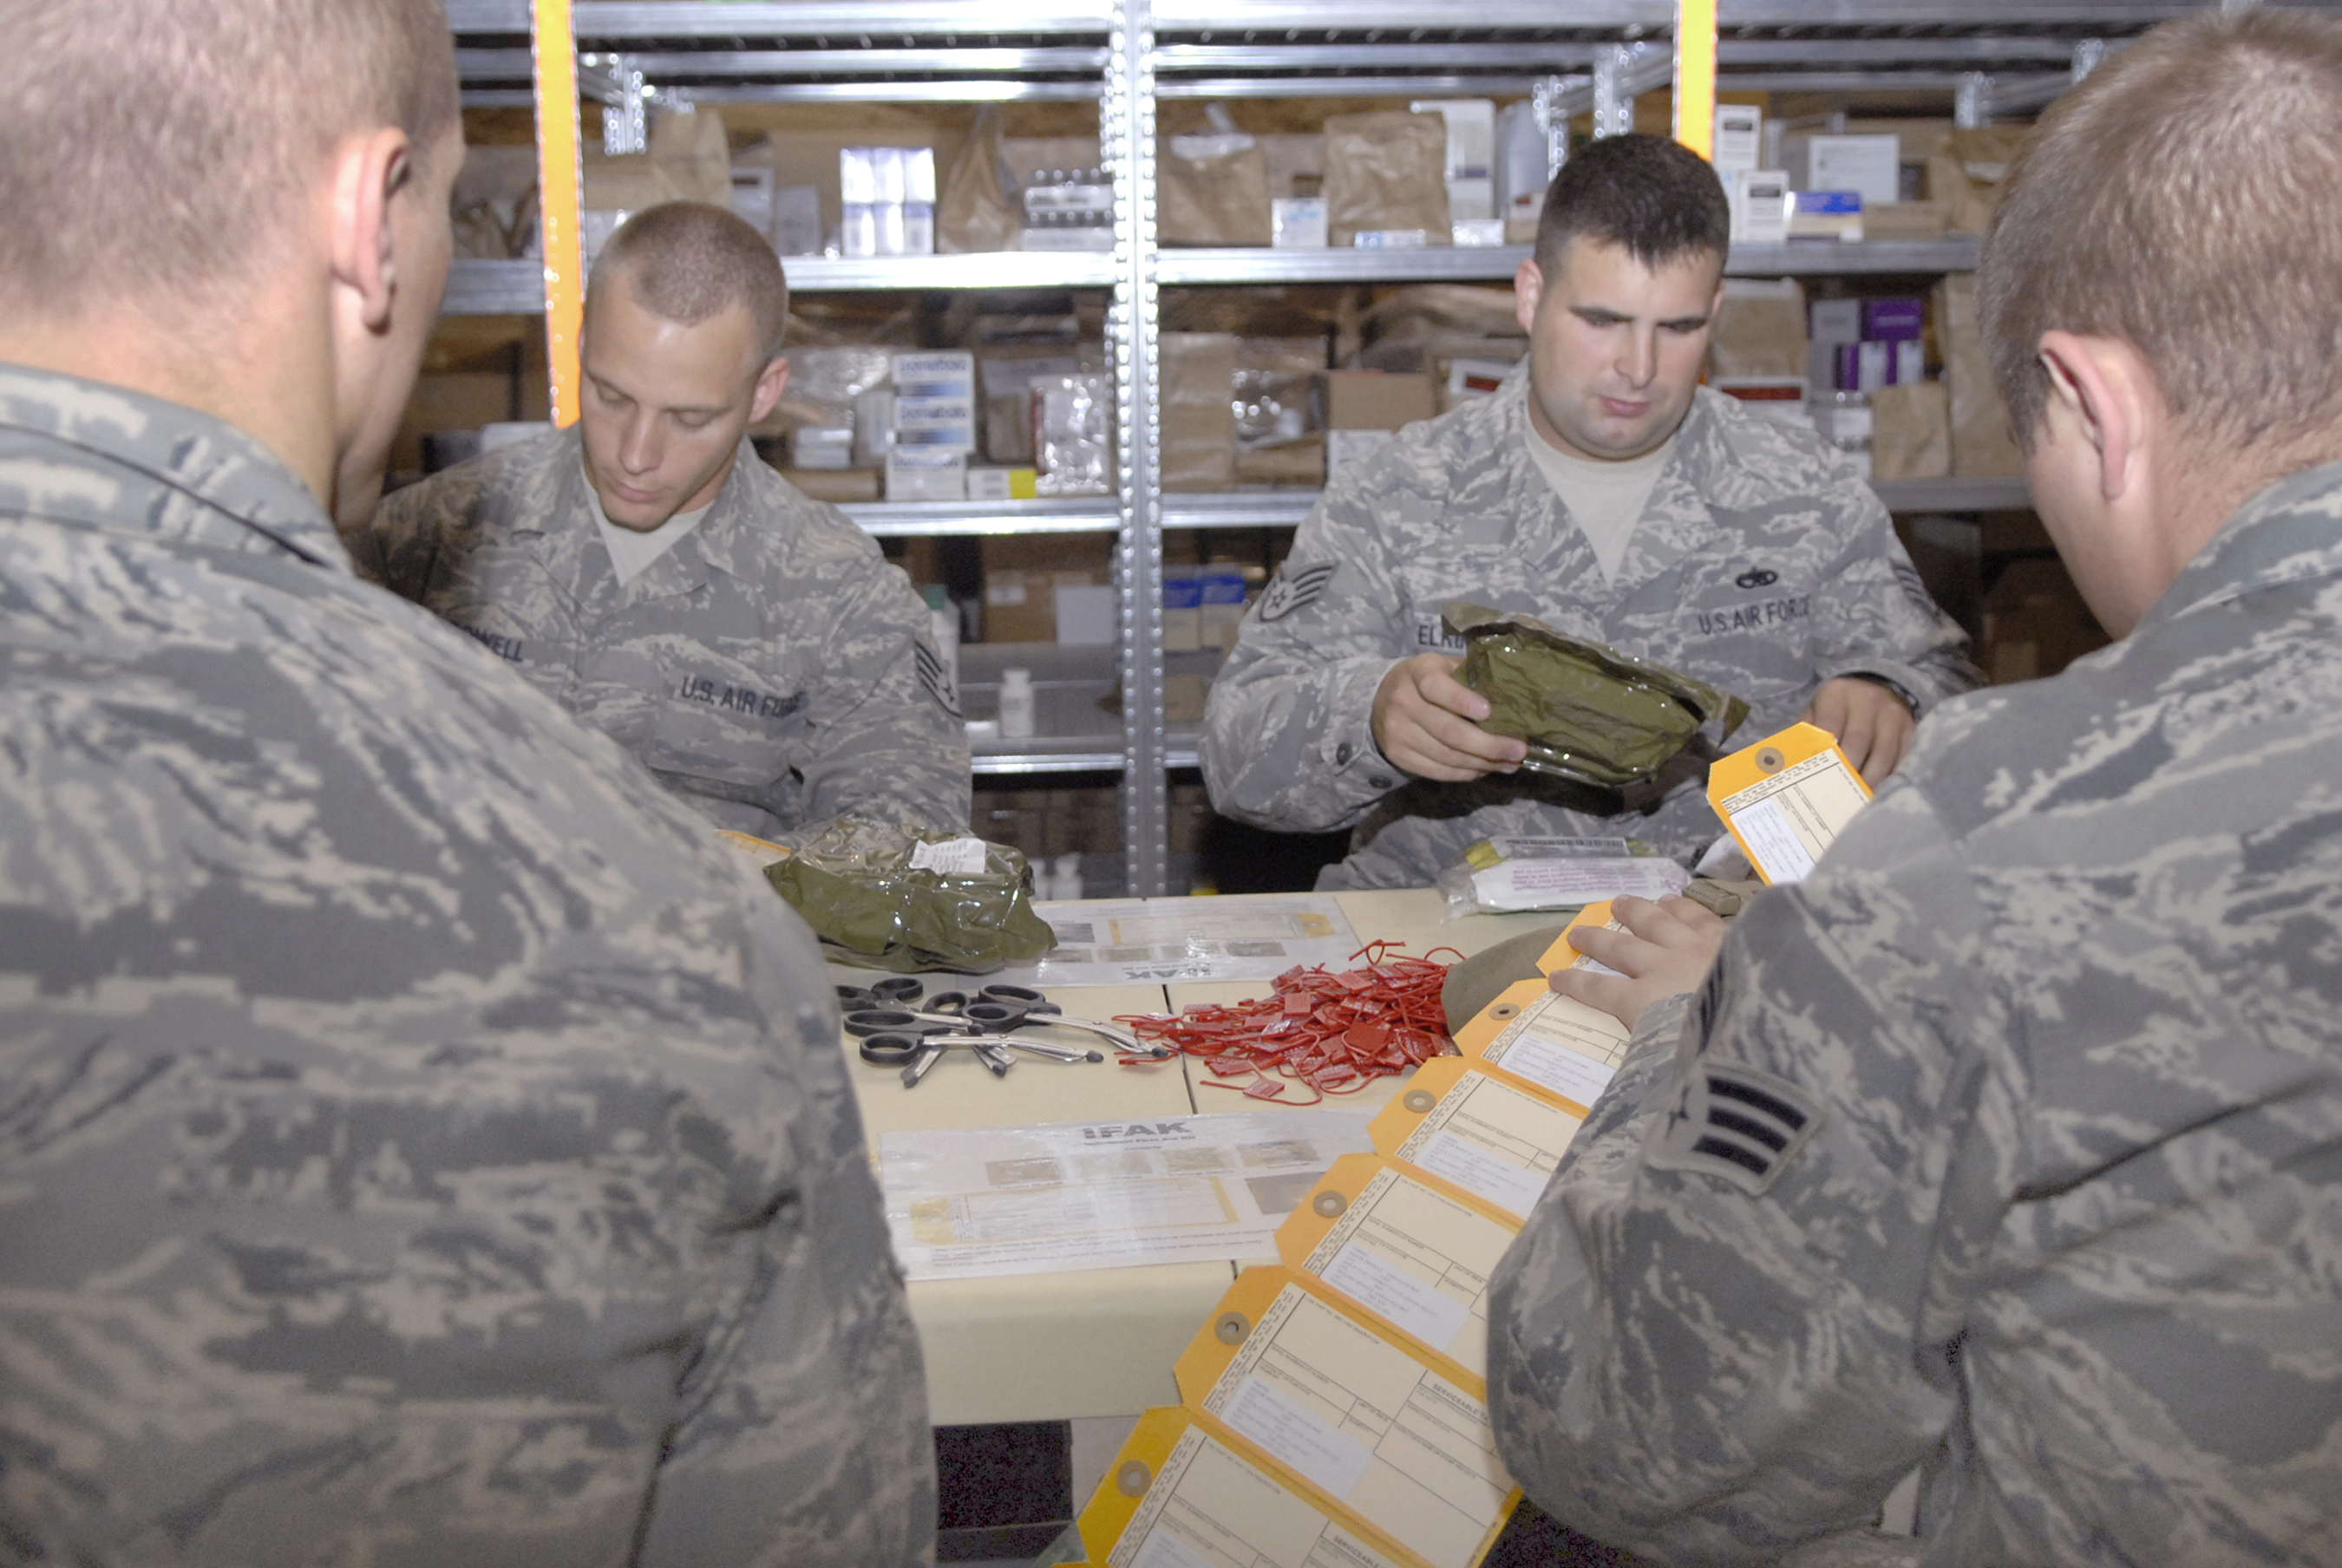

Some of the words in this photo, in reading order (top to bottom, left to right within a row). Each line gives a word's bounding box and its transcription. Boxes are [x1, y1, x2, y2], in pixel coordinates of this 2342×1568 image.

[1733, 604, 1763, 629] AIR
[682, 676, 714, 705] U.S.
[720, 687, 756, 715] AIR
[1082, 1121, 1191, 1140] IFAK
[1431, 1381, 1479, 1416] SERVICEABLE
